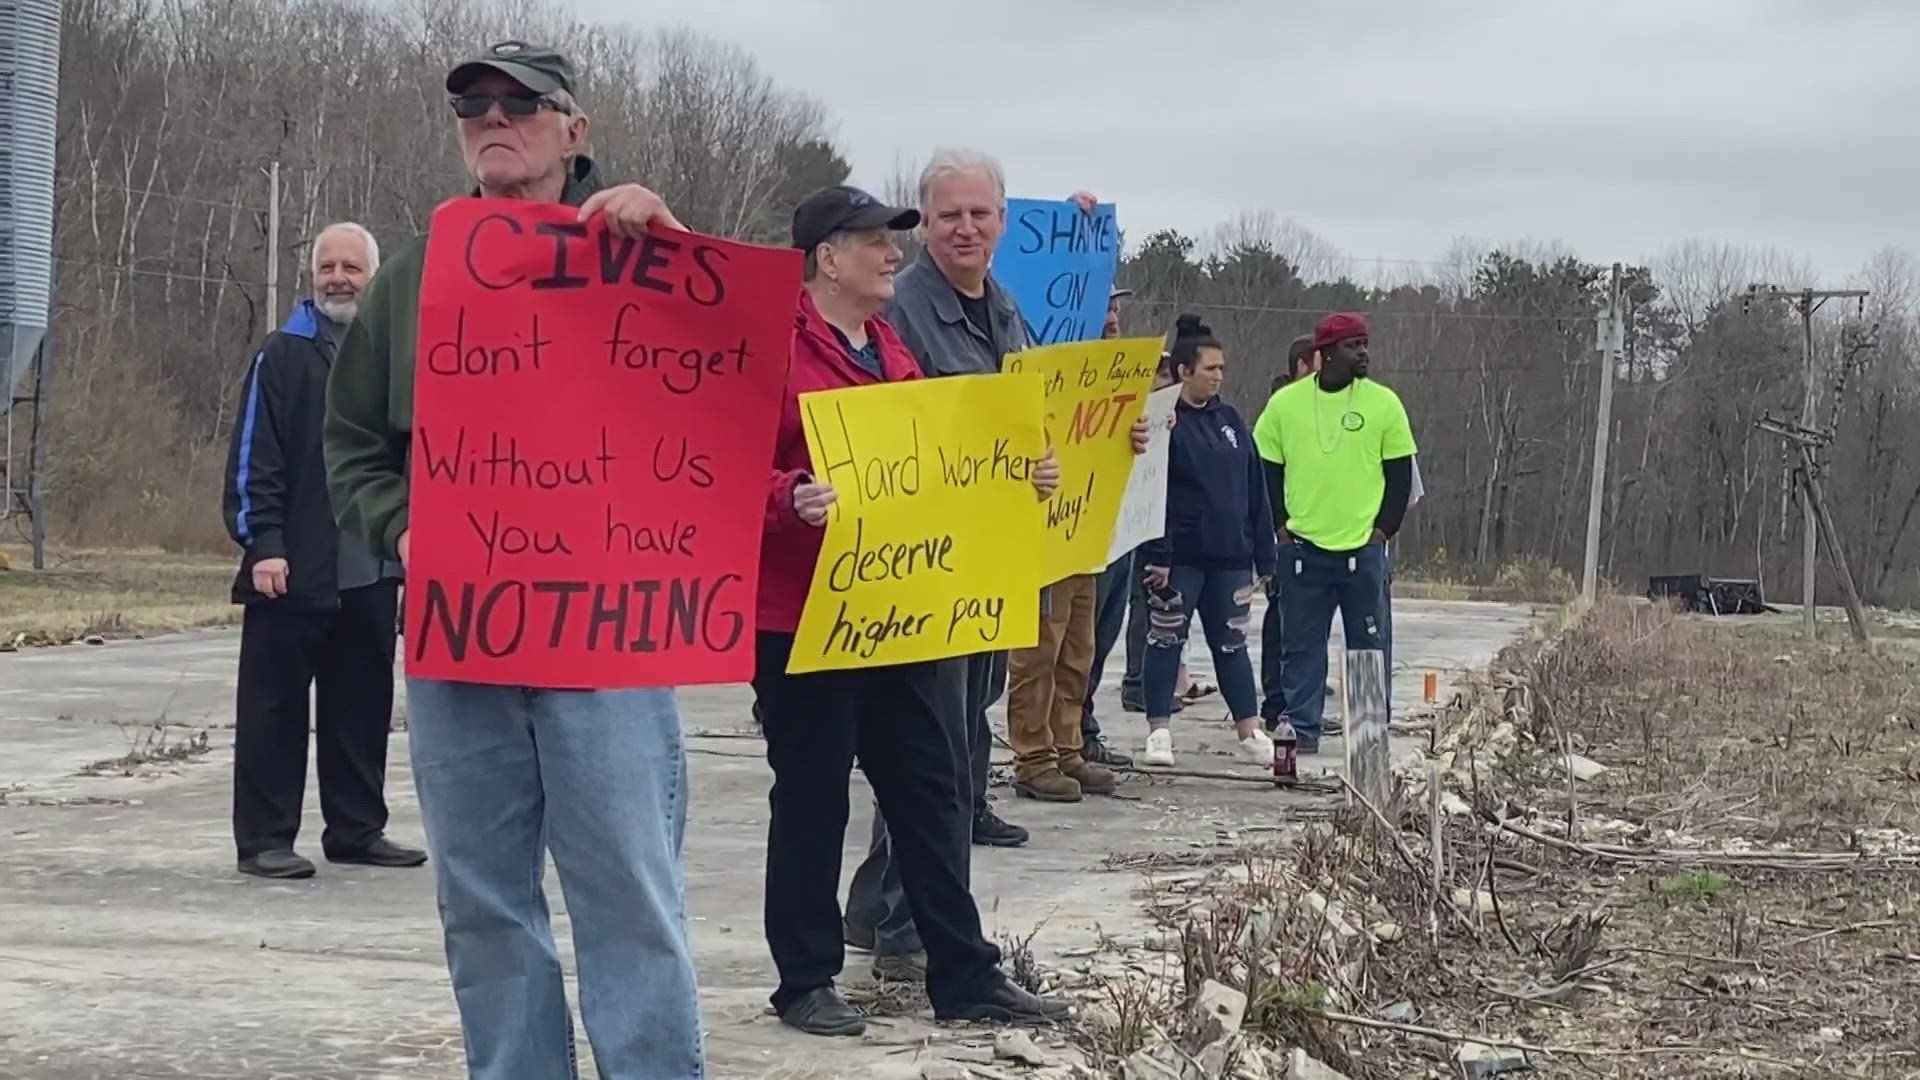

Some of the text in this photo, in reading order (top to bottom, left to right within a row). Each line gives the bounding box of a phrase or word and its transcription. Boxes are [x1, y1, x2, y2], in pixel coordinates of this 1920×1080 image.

[466, 213, 730, 307] CIVES
[1019, 208, 1112, 254] SHAME
[1046, 270, 1090, 312] ON
[428, 303, 755, 395] don't forget
[1078, 357, 1097, 388] to
[1066, 391, 1137, 445] NOT
[420, 426, 715, 490] Without Us
[806, 400, 1039, 523] Hard Worker
[605, 503, 698, 558] have
[828, 517, 954, 592] deserve
[416, 572, 744, 663] NOTHING
[822, 597, 1004, 659] higher pay
